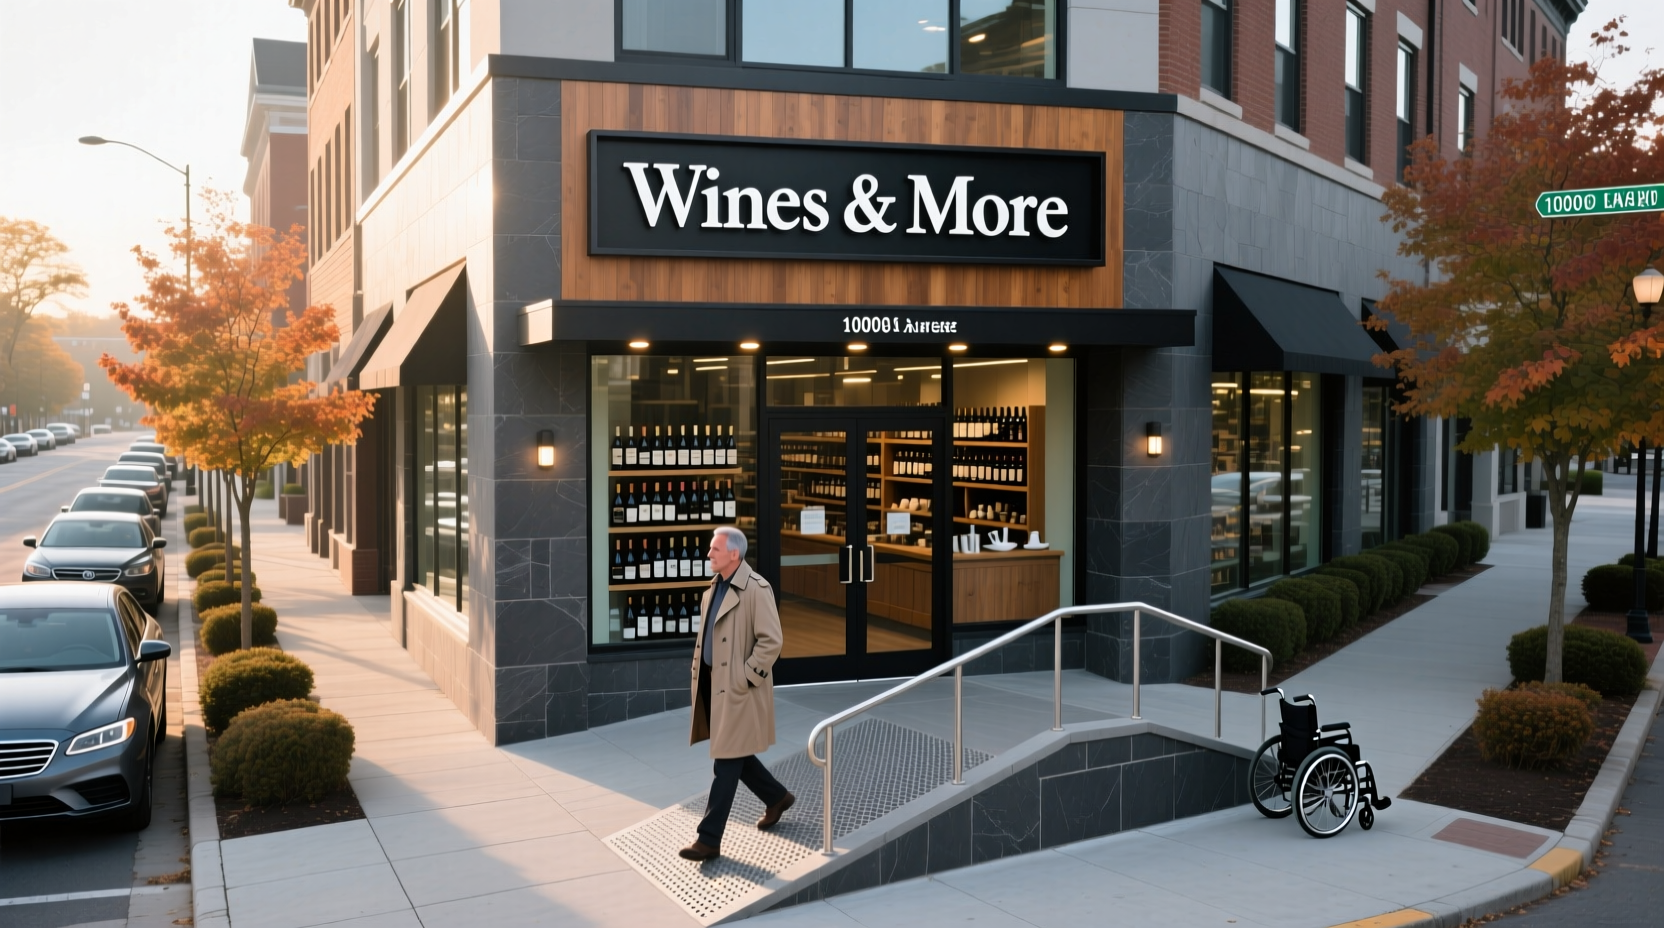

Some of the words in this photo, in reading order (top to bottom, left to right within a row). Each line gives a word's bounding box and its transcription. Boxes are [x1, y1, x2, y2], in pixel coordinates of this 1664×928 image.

[623, 162, 829, 232] Wines
[843, 173, 897, 233] &
[906, 174, 1069, 238] More
